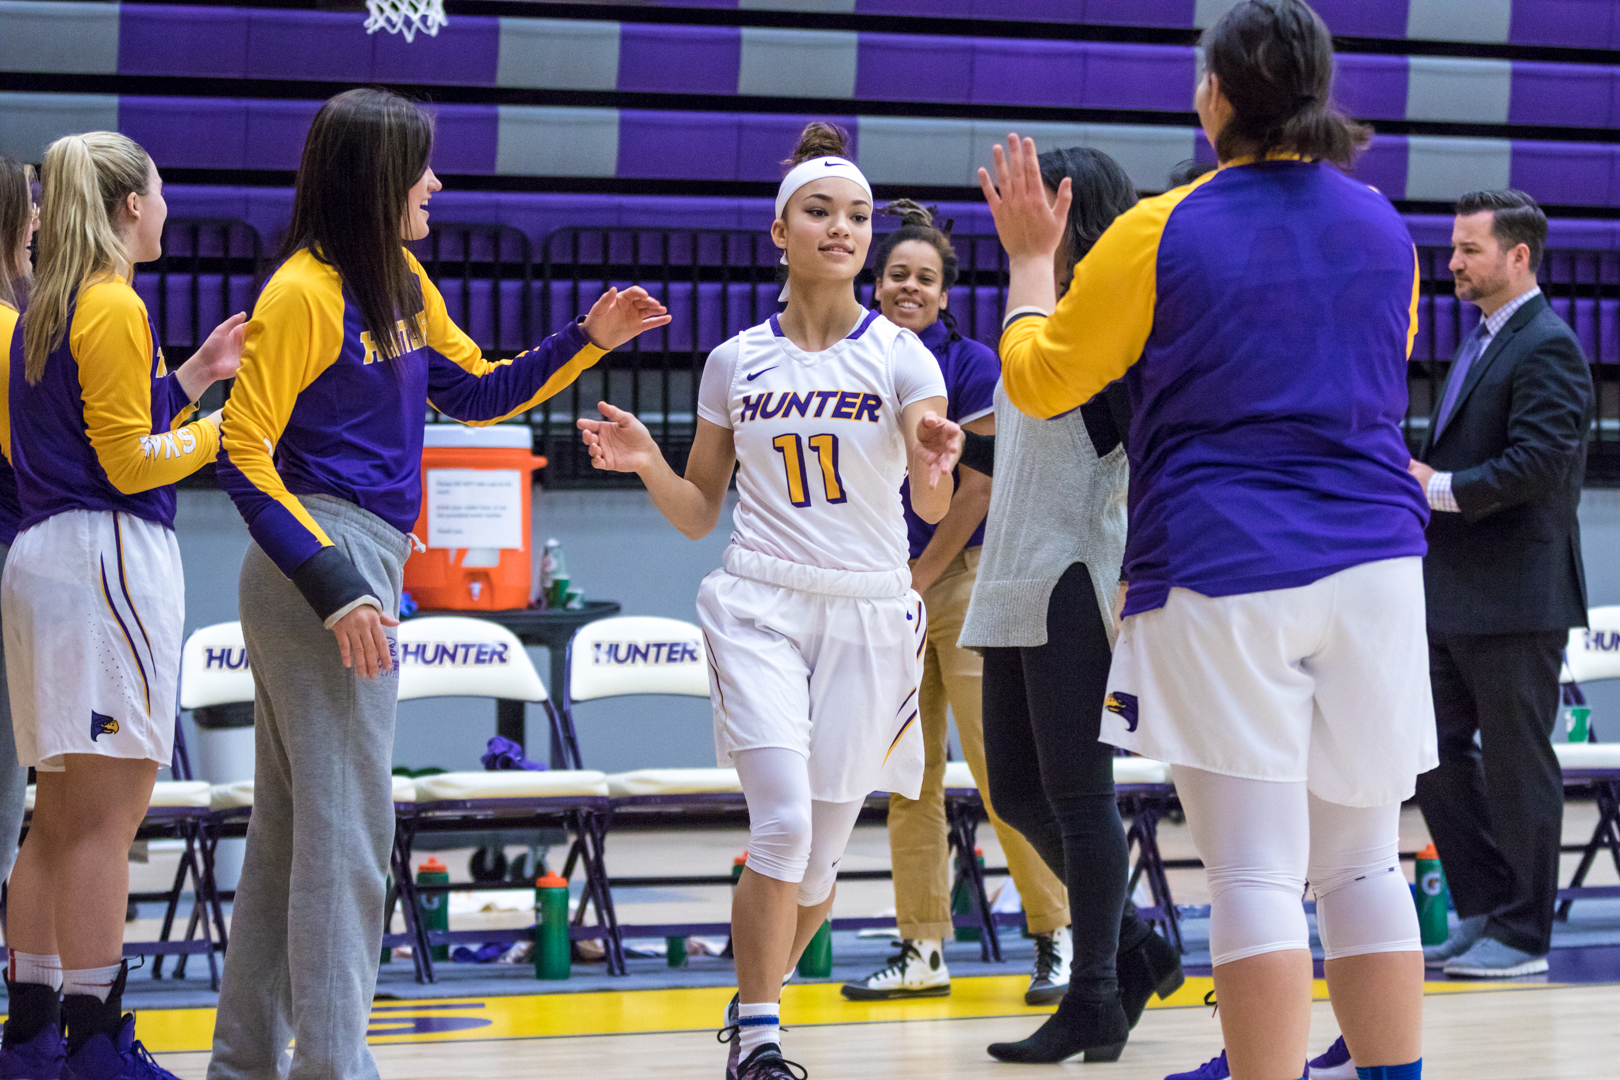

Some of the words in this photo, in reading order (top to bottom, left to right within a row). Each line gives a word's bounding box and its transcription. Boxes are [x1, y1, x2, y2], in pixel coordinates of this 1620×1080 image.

[740, 390, 883, 424] HUNTER
[772, 433, 847, 508] 11
[401, 642, 509, 665] HUNTER
[594, 642, 699, 664] HUNTER
